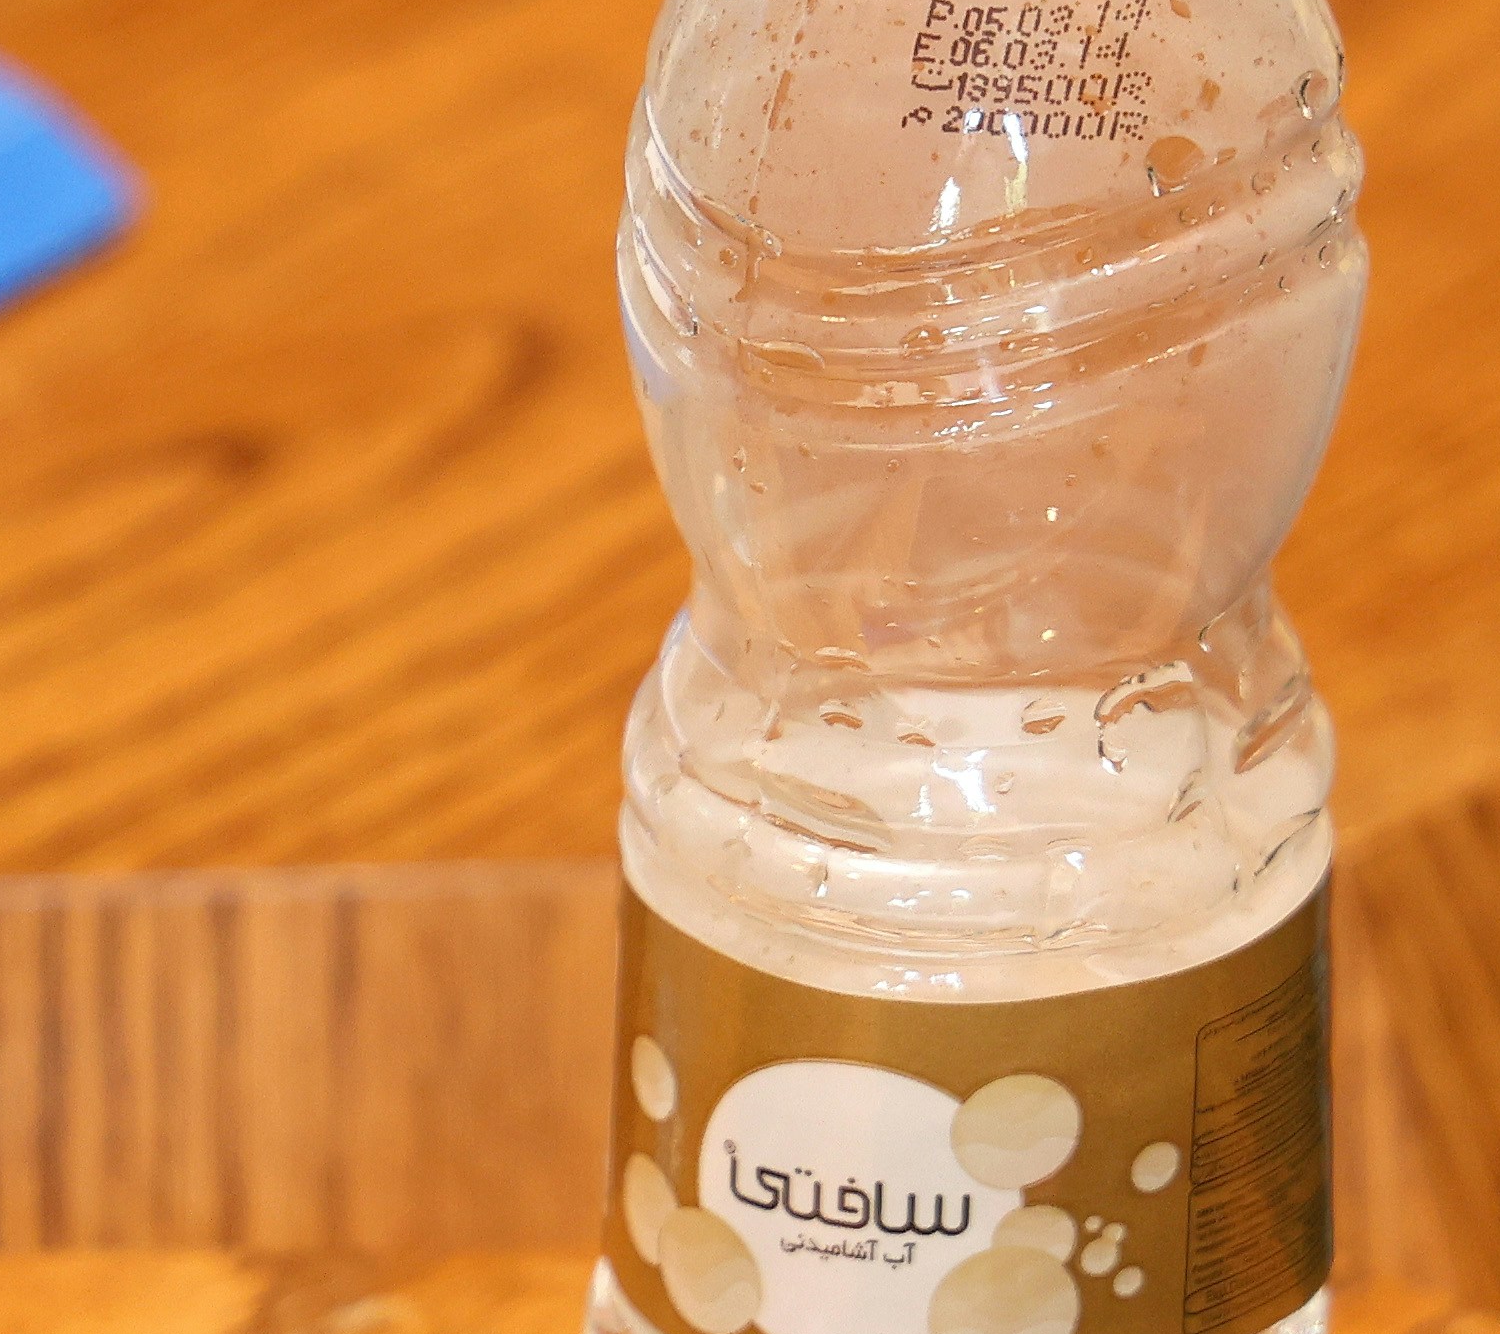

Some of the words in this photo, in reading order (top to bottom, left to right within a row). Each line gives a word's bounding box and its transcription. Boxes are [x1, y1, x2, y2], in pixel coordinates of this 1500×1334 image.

[912, 31, 1131, 69] E.06.03.14
[729, 1154, 971, 1236] سافتی
[780, 1233, 879, 1261] آشامیدنی
[882, 1242, 916, 1270] آب
